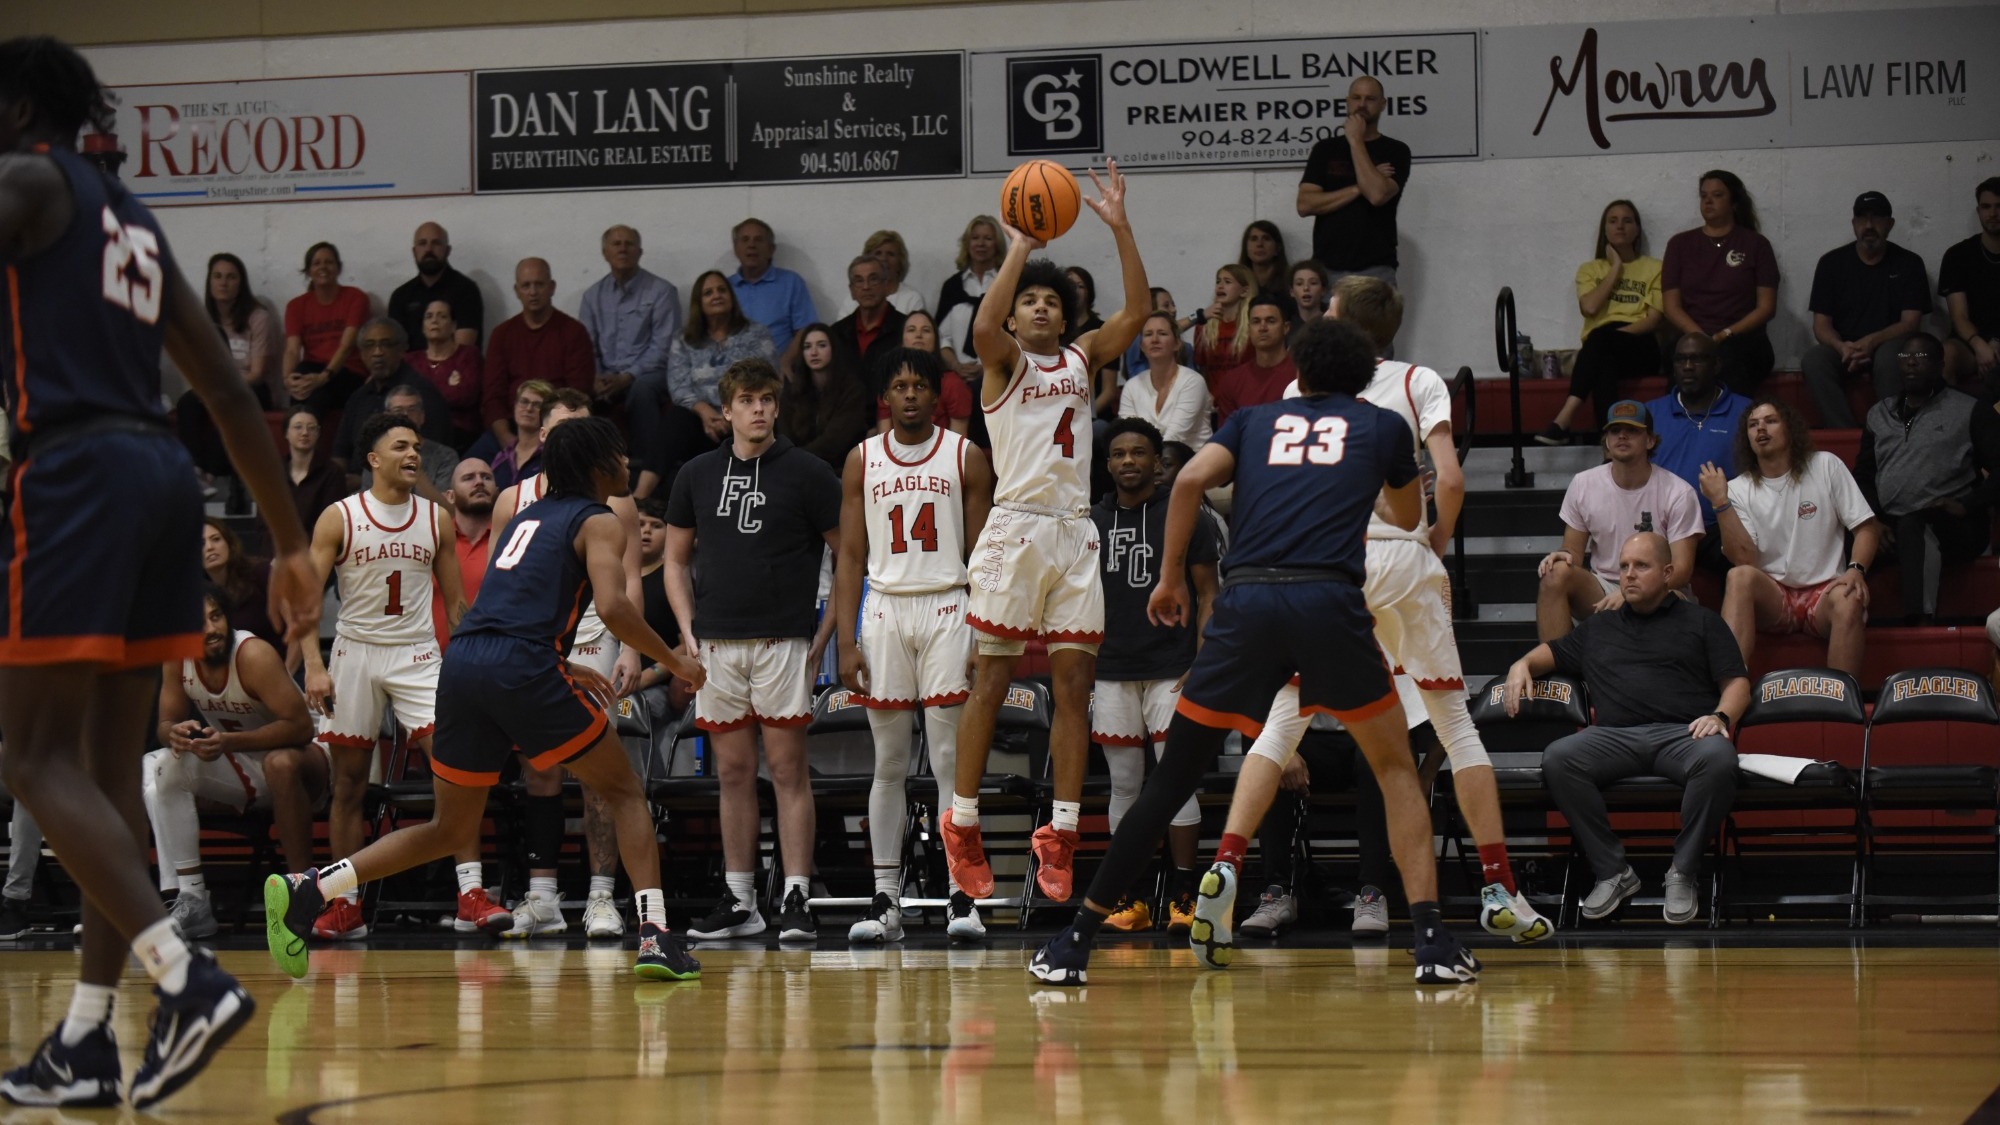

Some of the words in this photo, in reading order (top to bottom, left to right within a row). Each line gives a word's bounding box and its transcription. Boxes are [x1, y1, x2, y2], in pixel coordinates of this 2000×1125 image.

[784, 65, 858, 89] Sunshine
[863, 62, 915, 89] Realty
[1109, 55, 1291, 86] COLDWELL
[1302, 48, 1439, 79] BANKER
[1803, 64, 1874, 100] LAW
[1886, 60, 1967, 96] FIRM
[841, 92, 857, 112] &
[1532, 27, 1777, 150] Mowrey
[181, 104, 208, 118] THE
[490, 91, 579, 139] DAN
[593, 85, 711, 135] LANG
[1127, 101, 1249, 126] PREMIER
[1257, 95, 1428, 120] PROPEIES
[133, 104, 366, 178] RECORD
[751, 120, 829, 148] Appraisal
[833, 118, 907, 142] Services,
[911, 115, 949, 137] LLC
[491, 148, 600, 171] EVERYTHING
[604, 147, 648, 167] REAL
[651, 144, 713, 165] ESTATE
[800, 150, 900, 175] 904.501.6867
[1053, 407, 1075, 459] 4
[1267, 413, 1349, 467] 23
[716, 475, 767, 534] FC
[872, 475, 952, 504] FLAGLER
[495, 519, 542, 571] 0
[888, 502, 938, 555] 14
[354, 541, 432, 567] FLAGLER
[977, 513, 1013, 593] SAINTS
[1107, 527, 1154, 588] FC
[385, 570, 404, 616] 1
[196, 699, 256, 715] LAGLER
[1761, 676, 1845, 704] FLAGLER
[1893, 676, 1979, 703] FLAGLER
